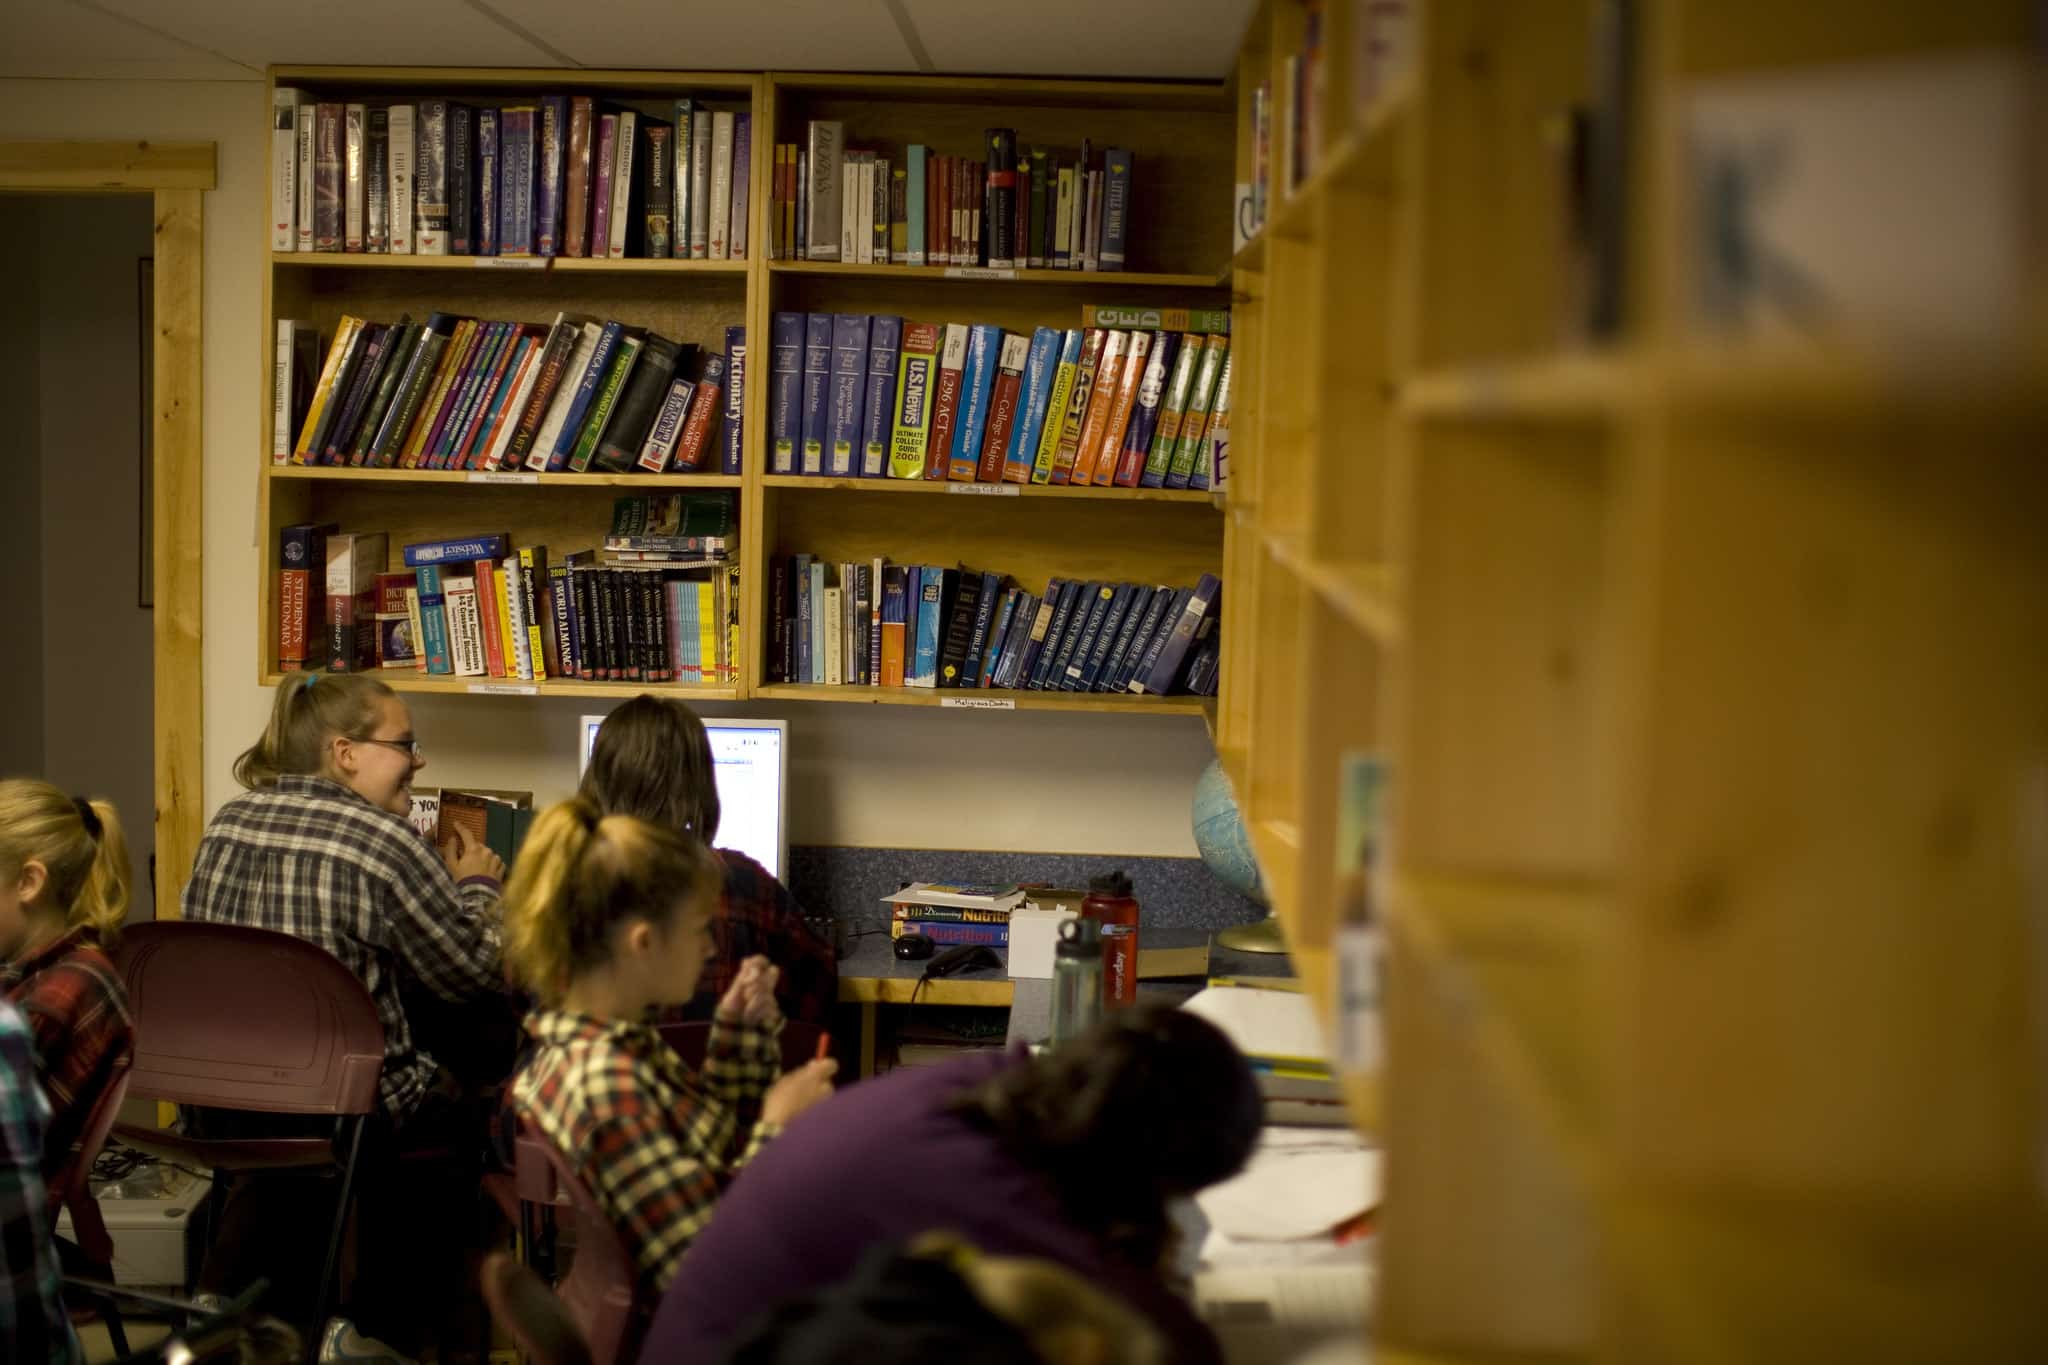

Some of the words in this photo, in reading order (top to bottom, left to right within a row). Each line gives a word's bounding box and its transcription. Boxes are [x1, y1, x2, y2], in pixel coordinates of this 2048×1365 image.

[455, 110, 467, 170] Chemistry
[419, 141, 431, 204] chemistry
[504, 144, 514, 184] POPULAR
[519, 144, 528, 184] POPULAR
[653, 141, 661, 187] PSYCHOLOGY
[504, 187, 513, 222] SCIENCE
[519, 186, 527, 221] SCIENCE
[1109, 179, 1125, 208] LITTLE
[1097, 309, 1161, 326] GED
[592, 331, 613, 369] AMERICA
[538, 361, 558, 398] LIVING
[726, 345, 746, 420] Dictionary
[940, 372, 955, 401] 1,296
[1053, 367, 1070, 404] Getting
[1098, 362, 1118, 397] SAT
[524, 399, 542, 430] WITH
[600, 392, 613, 412] AND
[700, 388, 714, 421] SCHOOL
[966, 405, 976, 427] Study
[1112, 397, 1128, 433] Practice
[684, 397, 704, 448] DICTIONARY
[937, 404, 950, 433] ACT
[992, 399, 1009, 435] College
[513, 431, 529, 450] ART
[687, 431, 701, 459] OFFICE
[731, 428, 740, 464] Students
[895, 437, 923, 446] COLLEGE
[962, 430, 972, 452] Guide
[987, 438, 1001, 472] Majors
[1040, 448, 1050, 465] Aid
[524, 569, 534, 593] English
[281, 572, 293, 647] DICTIONARY
[293, 577, 304, 644] STUDENT'S
[466, 595, 474, 608] The
[468, 609, 476, 622] New
[526, 593, 536, 625] Grammar
[555, 586, 568, 622] WORLD
[977, 603, 989, 628] HOLY
[459, 607, 469, 640] Crossword
[1052, 608, 1066, 632] HOLY
[1069, 609, 1084, 634] HOLY
[1087, 610, 1102, 634] HOLY
[1104, 610, 1119, 635] HOLY
[1123, 612, 1138, 636] HOLY
[1141, 611, 1156, 636] HOLY
[1160, 613, 1176, 638] HOLY
[462, 640, 473, 671] Dictionary
[467, 623, 481, 670] Comprehensive
[559, 621, 572, 666] ALMANAC
[972, 629, 983, 653] BIBLE
[1044, 633, 1057, 658] BIBLE
[1060, 635, 1075, 658] BIBLE
[1077, 634, 1092, 659] BIBLE
[1094, 635, 1109, 659] BIBLE
[1112, 636, 1128, 661] BIBLE
[1130, 636, 1145, 660] BIBLE
[1149, 637, 1164, 661] BIBLE
[419, 800, 438, 812] YOU
[927, 926, 993, 943] Nutrition
[1112, 952, 1128, 1000] everyday
